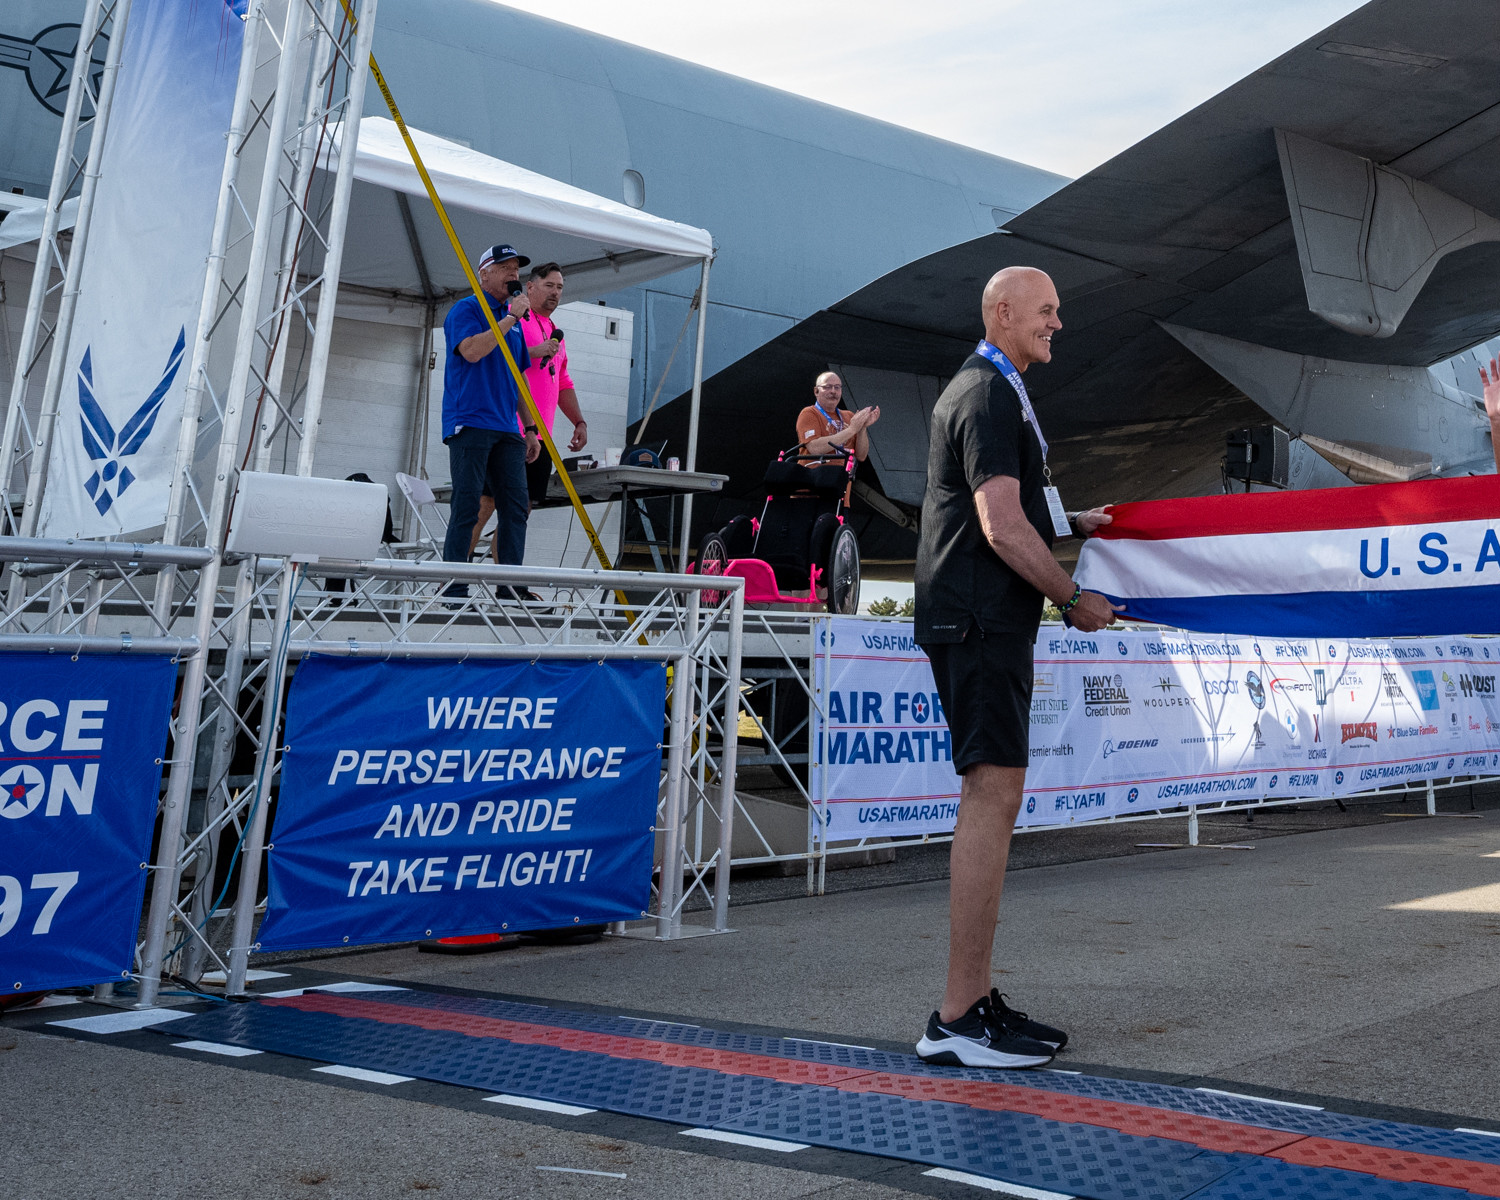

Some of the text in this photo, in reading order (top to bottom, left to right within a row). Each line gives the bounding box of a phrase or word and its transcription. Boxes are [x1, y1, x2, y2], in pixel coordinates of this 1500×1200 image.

[1011, 372, 1022, 385] AIR
[862, 635, 921, 651] USAFMA
[1049, 640, 1099, 654] #FLYAFM
[1143, 642, 1241, 656] USAFMARATHON.COM
[1083, 675, 1112, 688] NAVY
[1204, 680, 1239, 695] oscar
[1340, 677, 1363, 686] ULTRA
[1084, 688, 1129, 700] FEDERAL
[820, 691, 884, 724] AIR
[1143, 698, 1196, 708] WOOLPERT
[426, 697, 558, 730] WHERE
[1085, 704, 1131, 717] Credit Union
[1396, 728, 1408, 738] Blue
[1409, 726, 1419, 736] Star
[1419, 725, 1438, 735] Families
[1052, 743, 1074, 756] Health
[1117, 739, 1159, 750] BOEING
[327, 746, 626, 786] PERSEVERANCE
[1055, 792, 1106, 811] #FLYAFM
[1157, 777, 1257, 799] USAFMARATHON.COM
[1289, 774, 1319, 787] #FLYAFM
[1360, 761, 1439, 781] USAFMARATHON.COM
[373, 798, 577, 839] AND PRIDE
[346, 849, 593, 898] TAKE FLIGHT!
